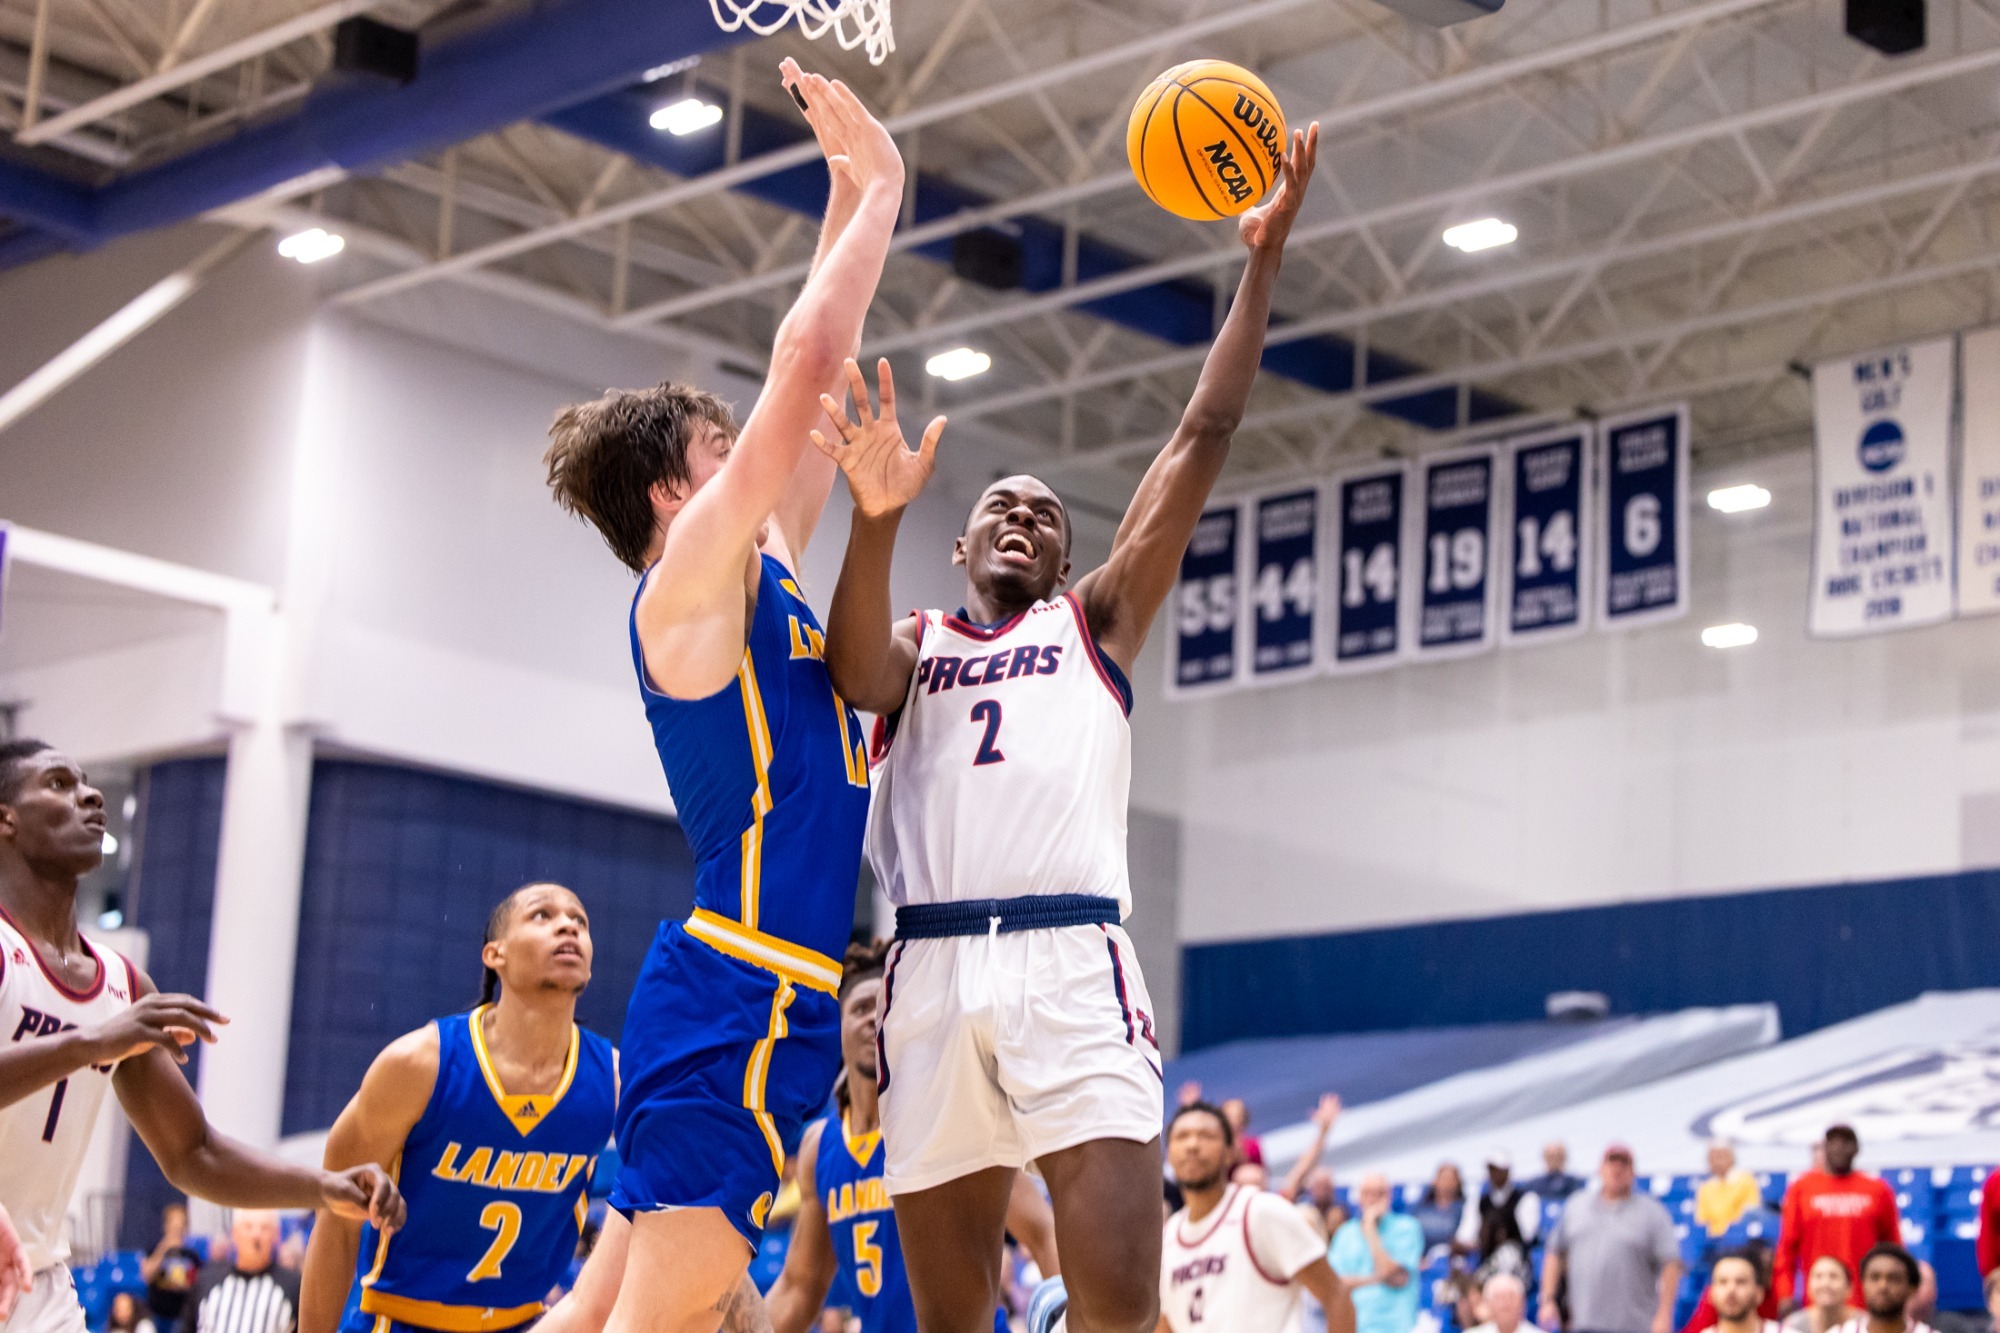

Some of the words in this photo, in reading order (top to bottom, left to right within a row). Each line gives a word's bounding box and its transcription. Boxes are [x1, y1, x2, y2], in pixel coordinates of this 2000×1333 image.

[1203, 140, 1254, 205] NCAA
[1517, 509, 1576, 579] 14
[1623, 493, 1662, 557] 6
[1254, 557, 1314, 621] 44
[1344, 542, 1397, 607] 14
[1428, 526, 1486, 595] 19
[1178, 572, 1237, 636] 55
[918, 645, 1063, 695] PACERS
[970, 699, 1006, 767] 2
[466, 1201, 522, 1283] 2
[852, 1220, 883, 1297] 5
